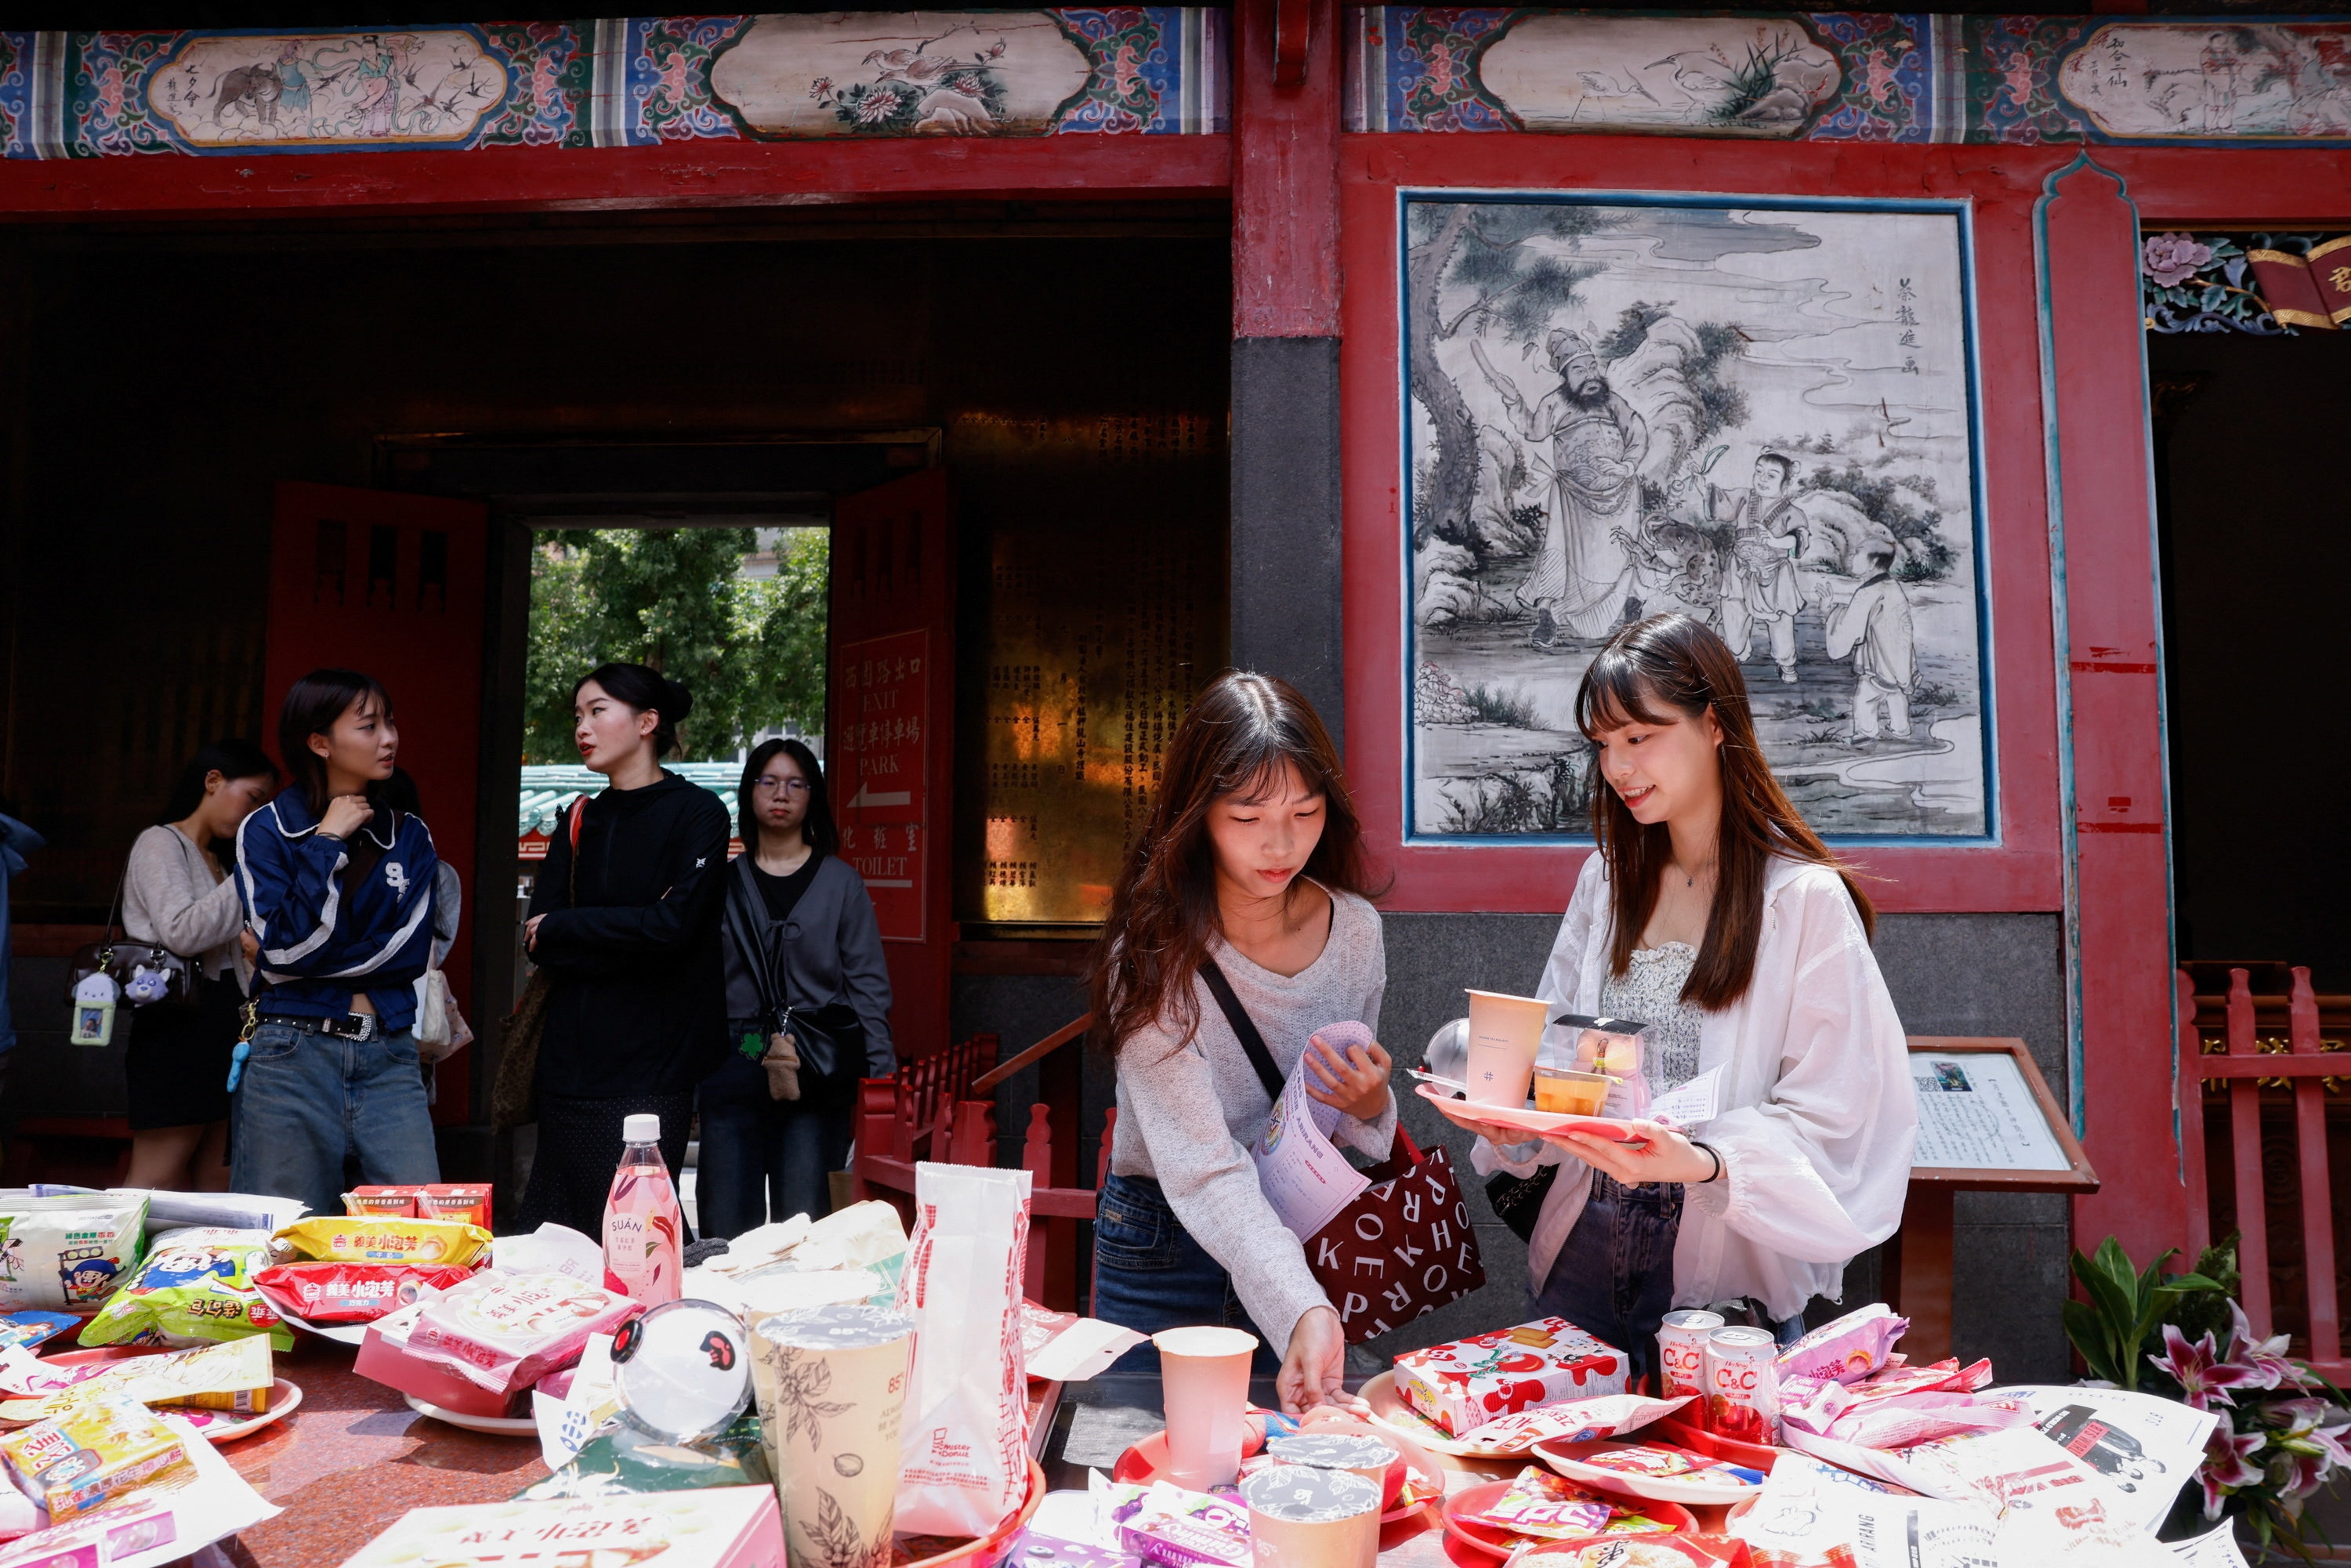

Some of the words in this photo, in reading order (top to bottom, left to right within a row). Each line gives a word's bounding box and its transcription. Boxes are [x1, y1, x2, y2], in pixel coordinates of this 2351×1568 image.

[2106, 38, 2131, 87] 和合二仙
[863, 690, 900, 713] EXIT
[859, 753, 900, 777] PARK
[852, 856, 907, 877] TOILET
[1296, 1117, 1324, 1160] ARIRANG
[1425, 1175, 1446, 1205] P
[1403, 1190, 1420, 1223] R
[1455, 1201, 1469, 1229] O
[611, 1218, 643, 1233] SUÁN
[1355, 1213, 1384, 1240] O
[1431, 1219, 1452, 1251] H
[1317, 1237, 1344, 1270] K
[1393, 1234, 1424, 1267] K
[1458, 1241, 1473, 1274] E
[1354, 1256, 1384, 1279] E
[1423, 1264, 1447, 1292] O
[325, 1280, 396, 1298] 義美小泡芙
[1382, 1281, 1411, 1312] R
[187, 1298, 242, 1319] 造句包
[1342, 1291, 1368, 1323] P
[1663, 1348, 1700, 1371] C&C
[1715, 1368, 1758, 1390] C&C
[2085, 1423, 2104, 1439] BTS
